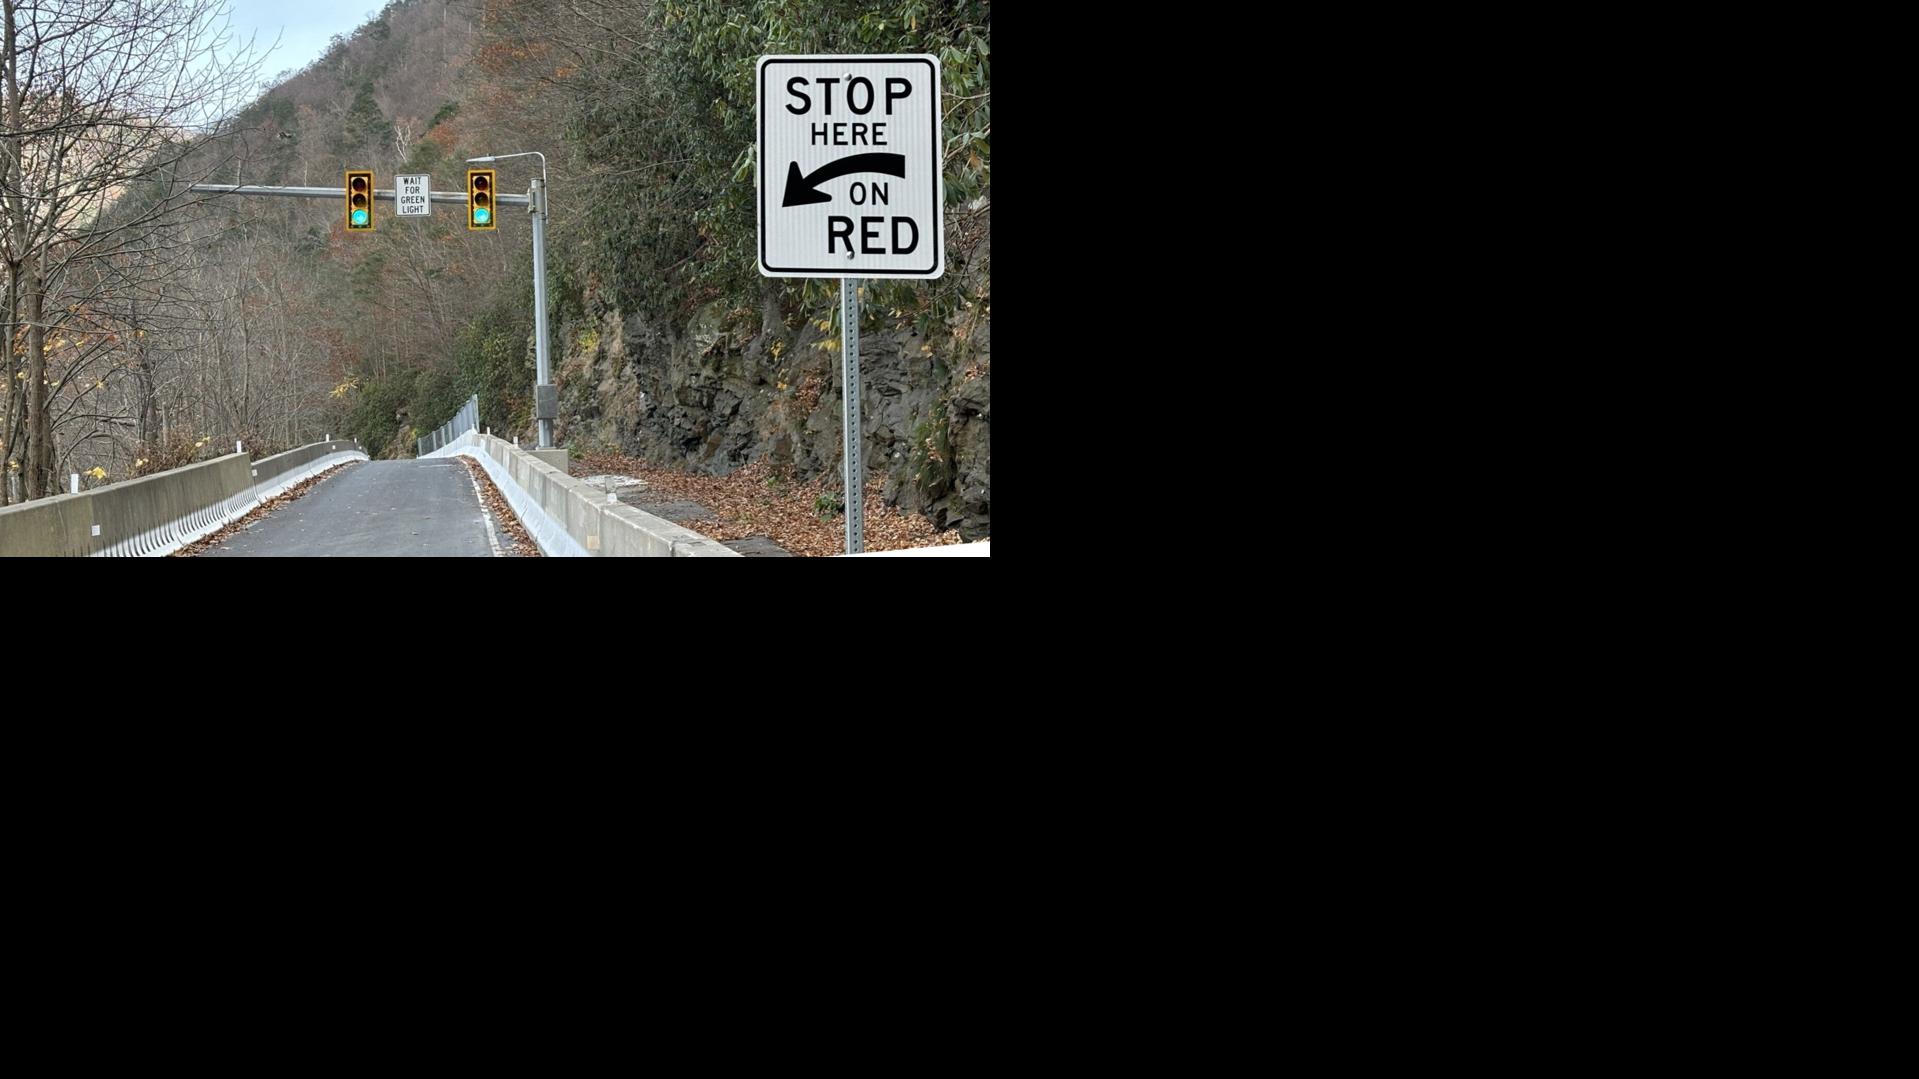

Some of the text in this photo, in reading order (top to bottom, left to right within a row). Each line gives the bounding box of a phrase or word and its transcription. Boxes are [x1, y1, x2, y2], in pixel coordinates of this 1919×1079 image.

[785, 76, 912, 115] STOP
[811, 122, 887, 146] HERE
[403, 177, 421, 185] WAIT
[405, 186, 420, 194] FOR
[849, 182, 889, 206] ON
[401, 196, 425, 204] GREEN
[402, 206, 424, 214] LIGHT
[828, 216, 919, 255] RED
